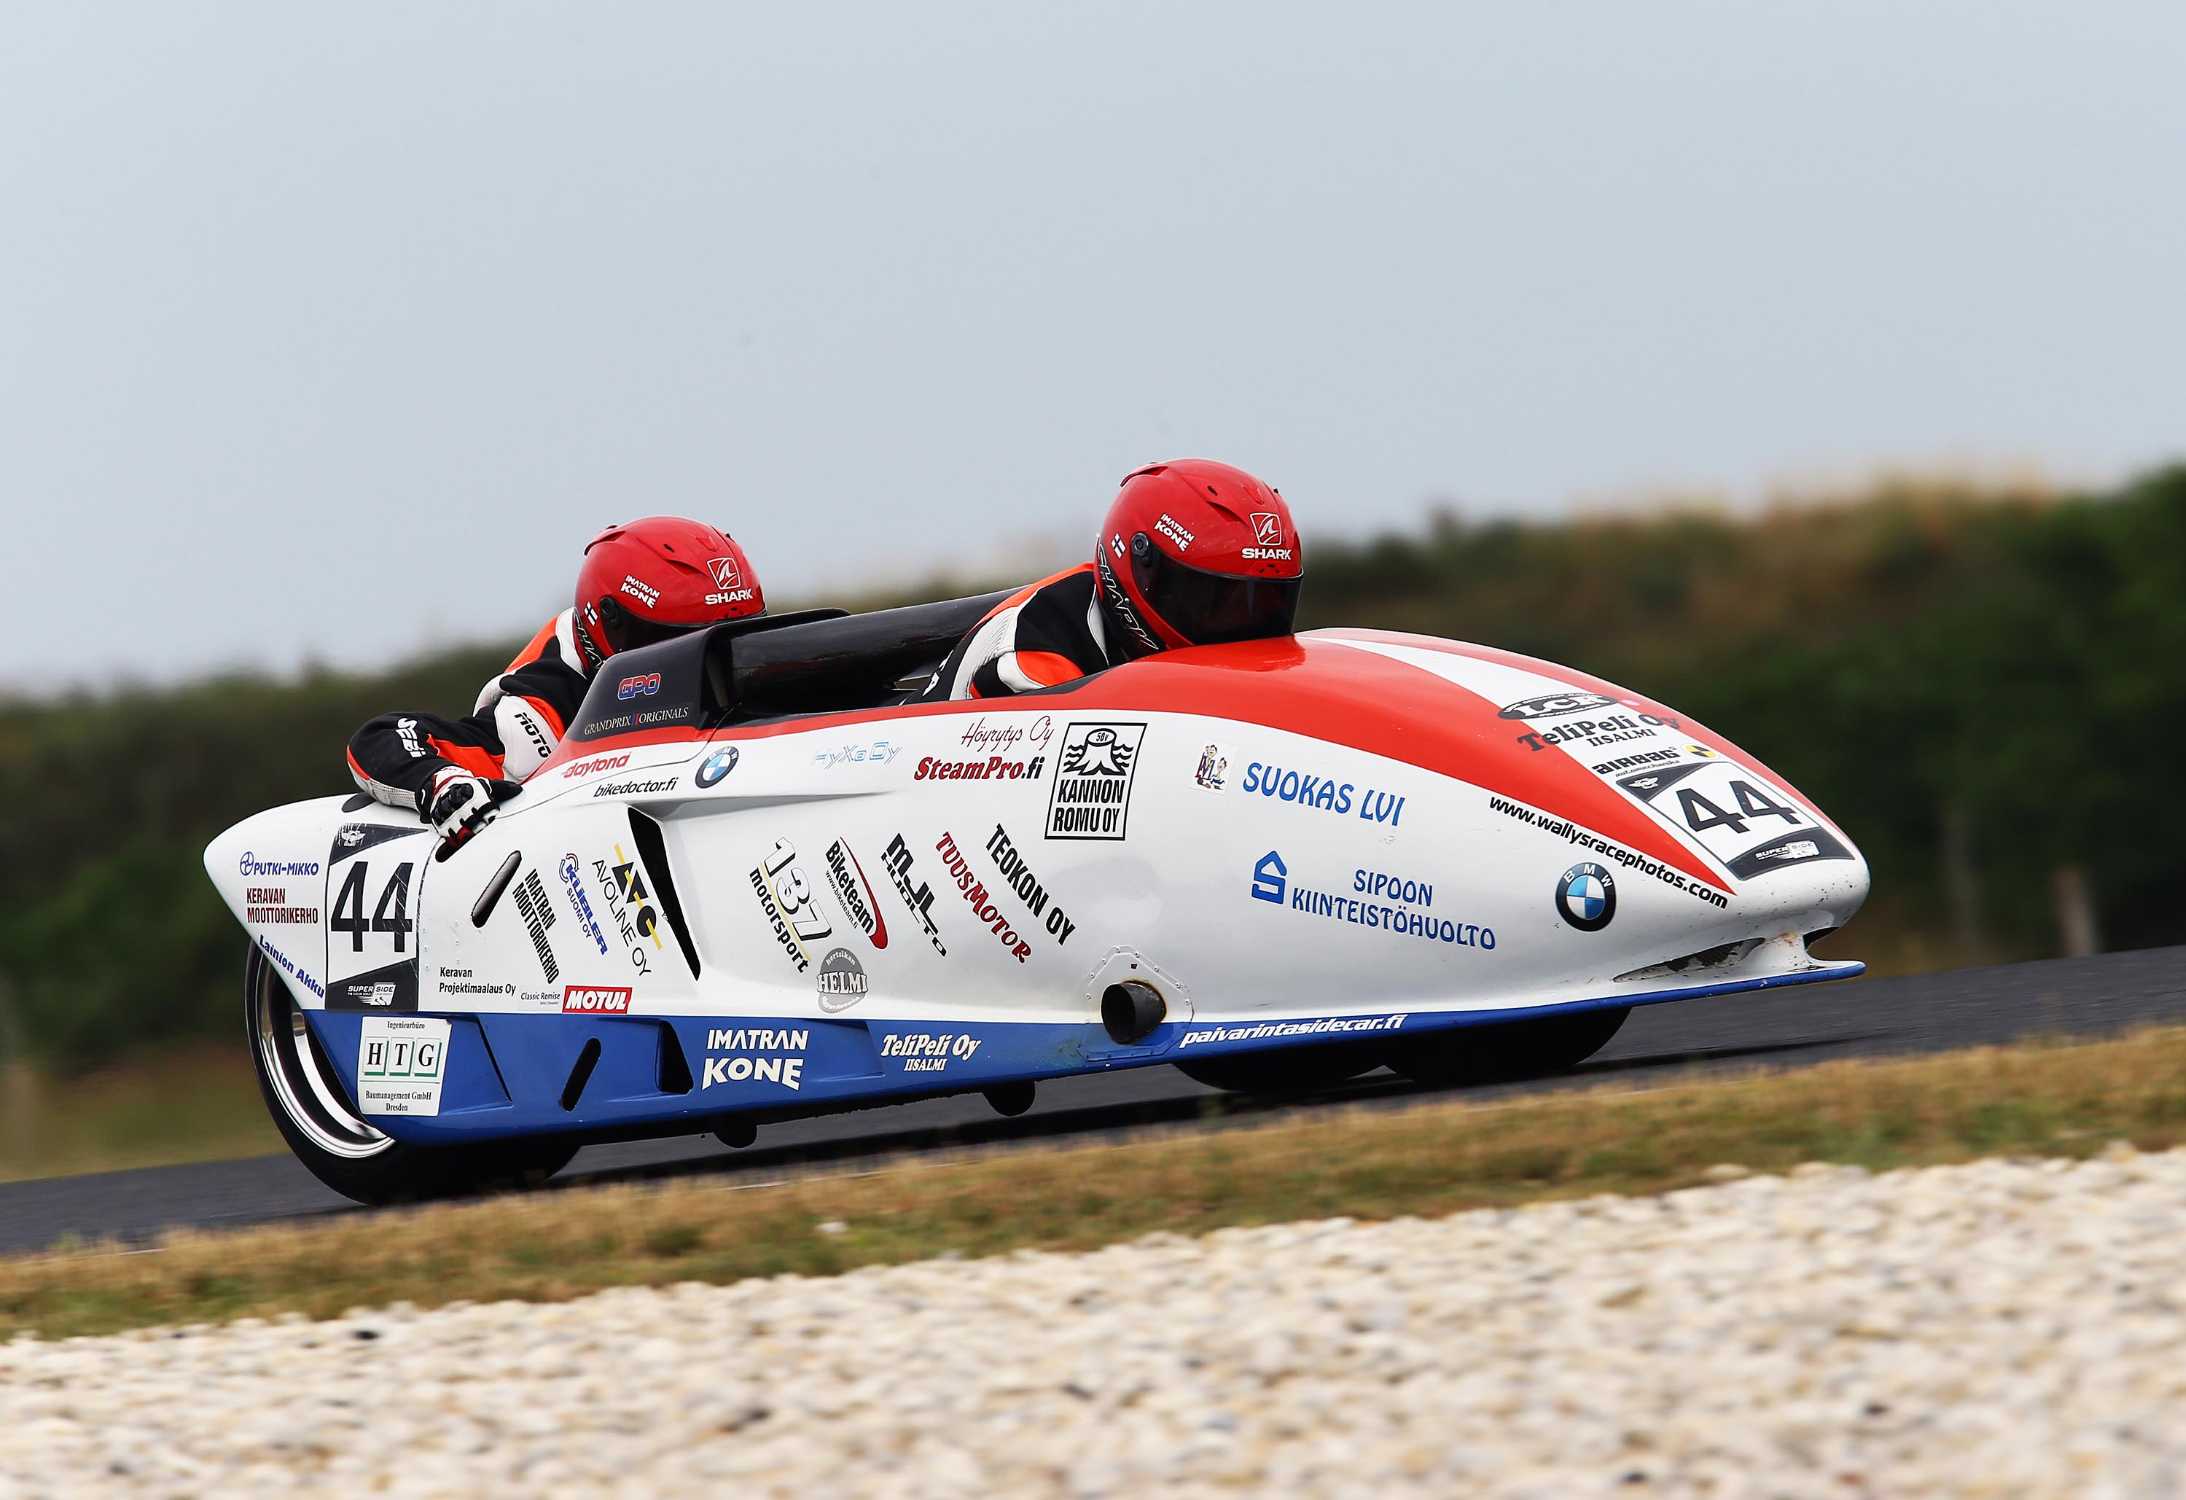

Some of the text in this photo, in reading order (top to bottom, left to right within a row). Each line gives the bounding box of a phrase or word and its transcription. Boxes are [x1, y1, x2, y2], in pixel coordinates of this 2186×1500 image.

[1154, 520, 1190, 552] KONE
[1160, 513, 1195, 542] IMATRAN
[1241, 548, 1293, 560] SHARK
[620, 582, 657, 609] KONE
[625, 574, 660, 599] IMATRAN
[704, 588, 753, 605] SHARK
[617, 672, 662, 701] GPO
[514, 712, 552, 758] MOTO
[584, 706, 688, 735] GRANDPRIX ORIGINALS
[1029, 715, 1055, 751] Oy
[1517, 715, 1639, 751] TeliPeli
[1586, 728, 1658, 747] IISALMI
[563, 752, 631, 779] daytona
[914, 756, 1045, 781] SteamPro.fi
[593, 776, 679, 798] bikedoctor.fi
[1057, 779, 1126, 804] KANNON
[1243, 762, 1354, 814] SUOKAS
[1053, 807, 1121, 832] ROMU OY
[1674, 780, 1803, 834] 44
[1489, 796, 1729, 909] www.wallysracephotos.com
[253, 862, 319, 876] PUTKI-MIKKO
[246, 888, 286, 904] KERAVAN
[524, 868, 557, 930] IMATRAN
[764, 836, 833, 941] 137
[825, 840, 875, 935] Biketeam
[935, 831, 1032, 963] TUUSMOTOR
[985, 823, 1076, 946] TEOKON OY
[1354, 869, 1433, 907] SIPOON
[247, 907, 319, 924] MOOTTORIKERHO
[330, 861, 414, 952] 44
[566, 887, 592, 939] SUOMI OY
[592, 860, 652, 976] AVOLINE OY
[750, 866, 809, 973] motorsport
[1292, 887, 1496, 950] KIINTEISTÖHUOLTO
[512, 881, 561, 984] MOOTTORIKERHO
[258, 934, 325, 998] Lainion Akku
[440, 966, 473, 978] Keravan
[348, 985, 374, 993] SUPER
[439, 982, 517, 996] Projektimaalaus Oy
[520, 992, 561, 1000] Classic Remise
[817, 970, 868, 994] HELMI
[565, 990, 627, 1010] MOTUL
[707, 1029, 808, 1050] IMATRAN
[1179, 1014, 1408, 1049] paivarintasidecar.fi
[880, 1033, 981, 1061] TeliPeli Oy
[701, 1057, 804, 1091] KONE
[904, 1058, 948, 1072] IISALMI
[365, 1090, 432, 1101] Baumanagement GmbH
[385, 1102, 409, 1112] Dresden
